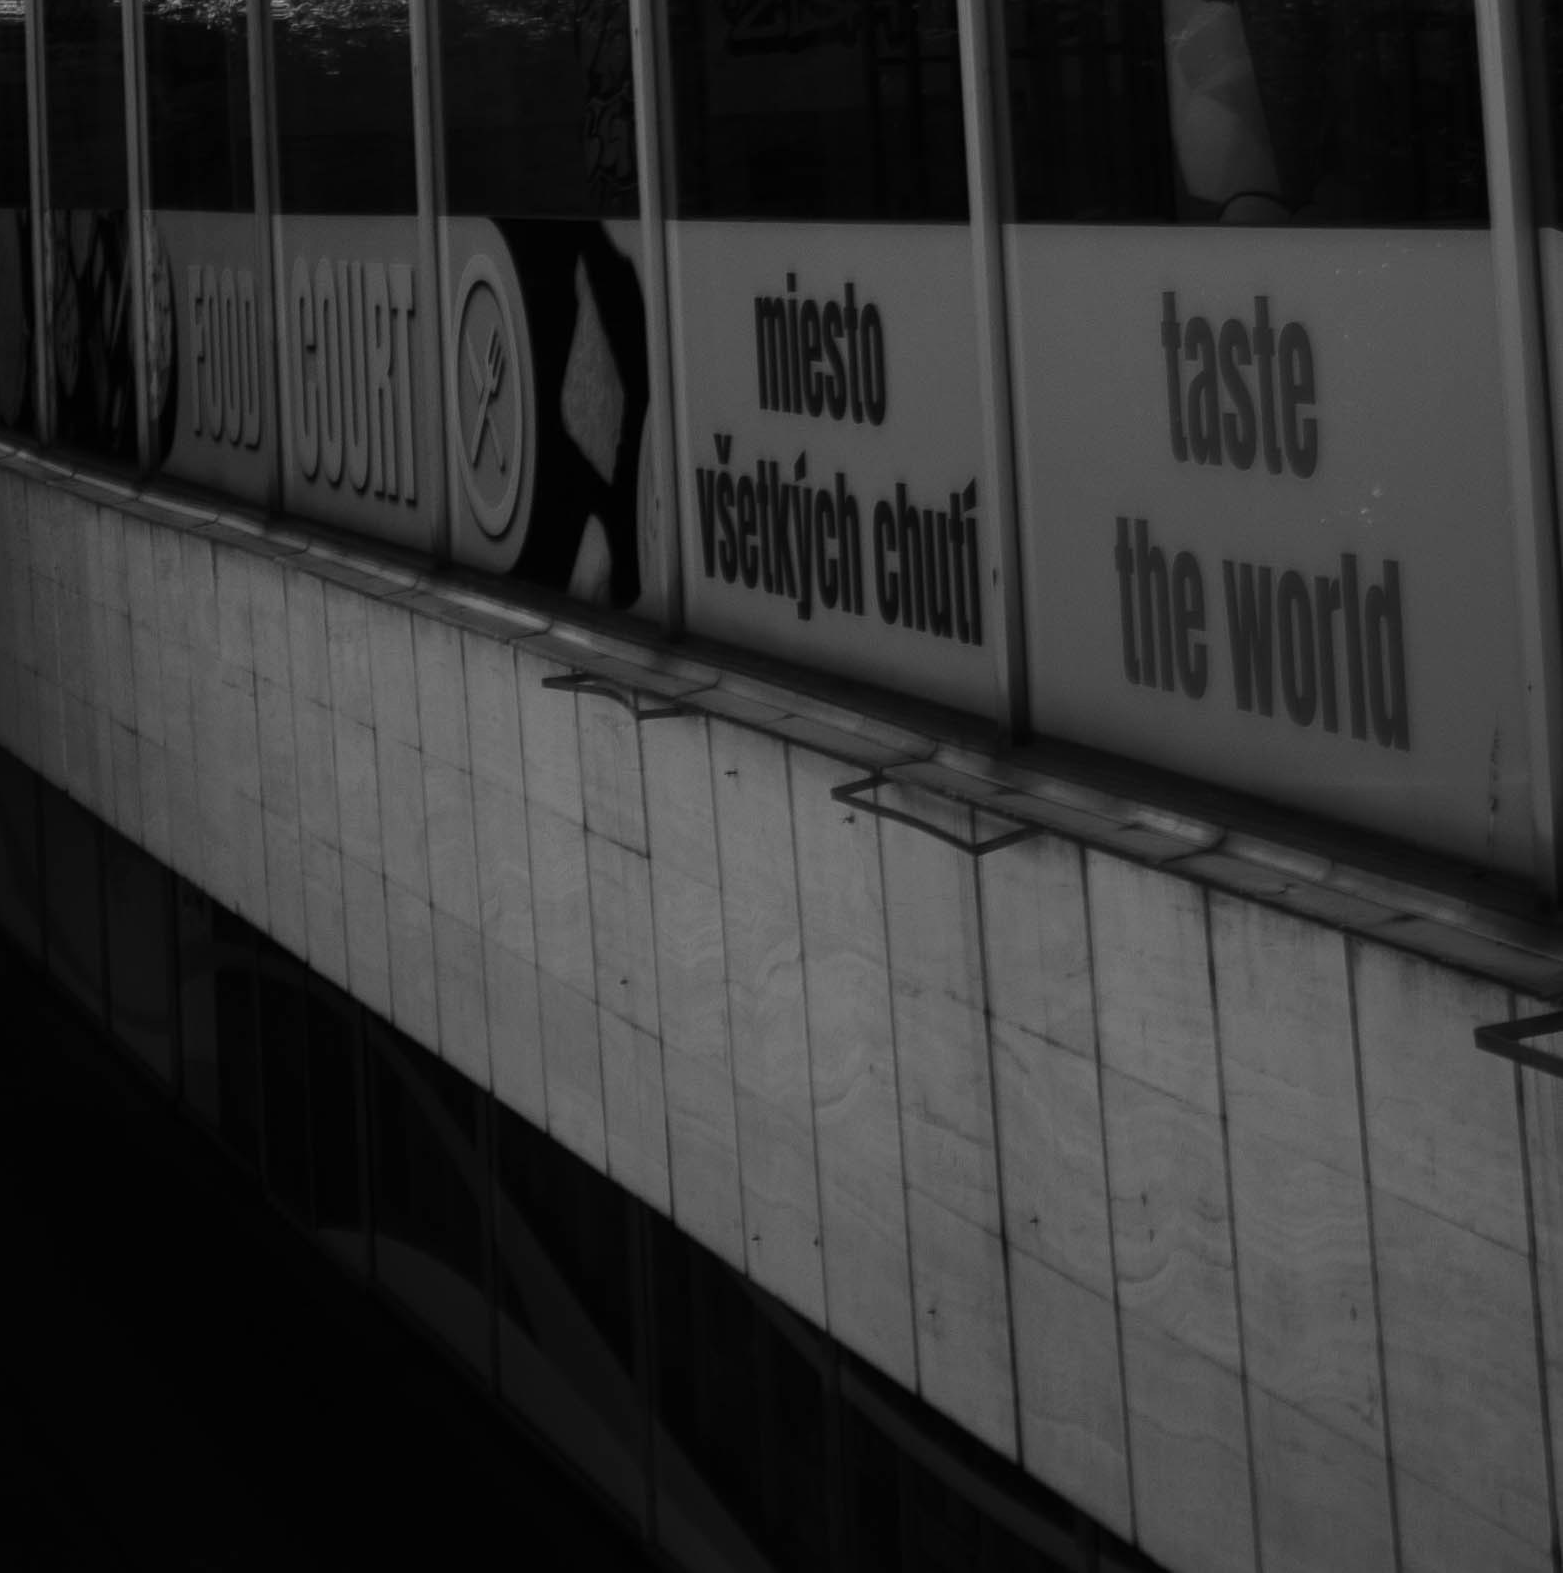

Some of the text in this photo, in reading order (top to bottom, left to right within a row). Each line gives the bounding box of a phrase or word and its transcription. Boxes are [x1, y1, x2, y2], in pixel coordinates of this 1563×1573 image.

[187, 255, 418, 507] FOOD COURT
[754, 272, 887, 427] miesto
[1161, 290, 1318, 479] taste
[695, 434, 983, 646] všetkých chutí
[1115, 516, 1410, 751] the world
